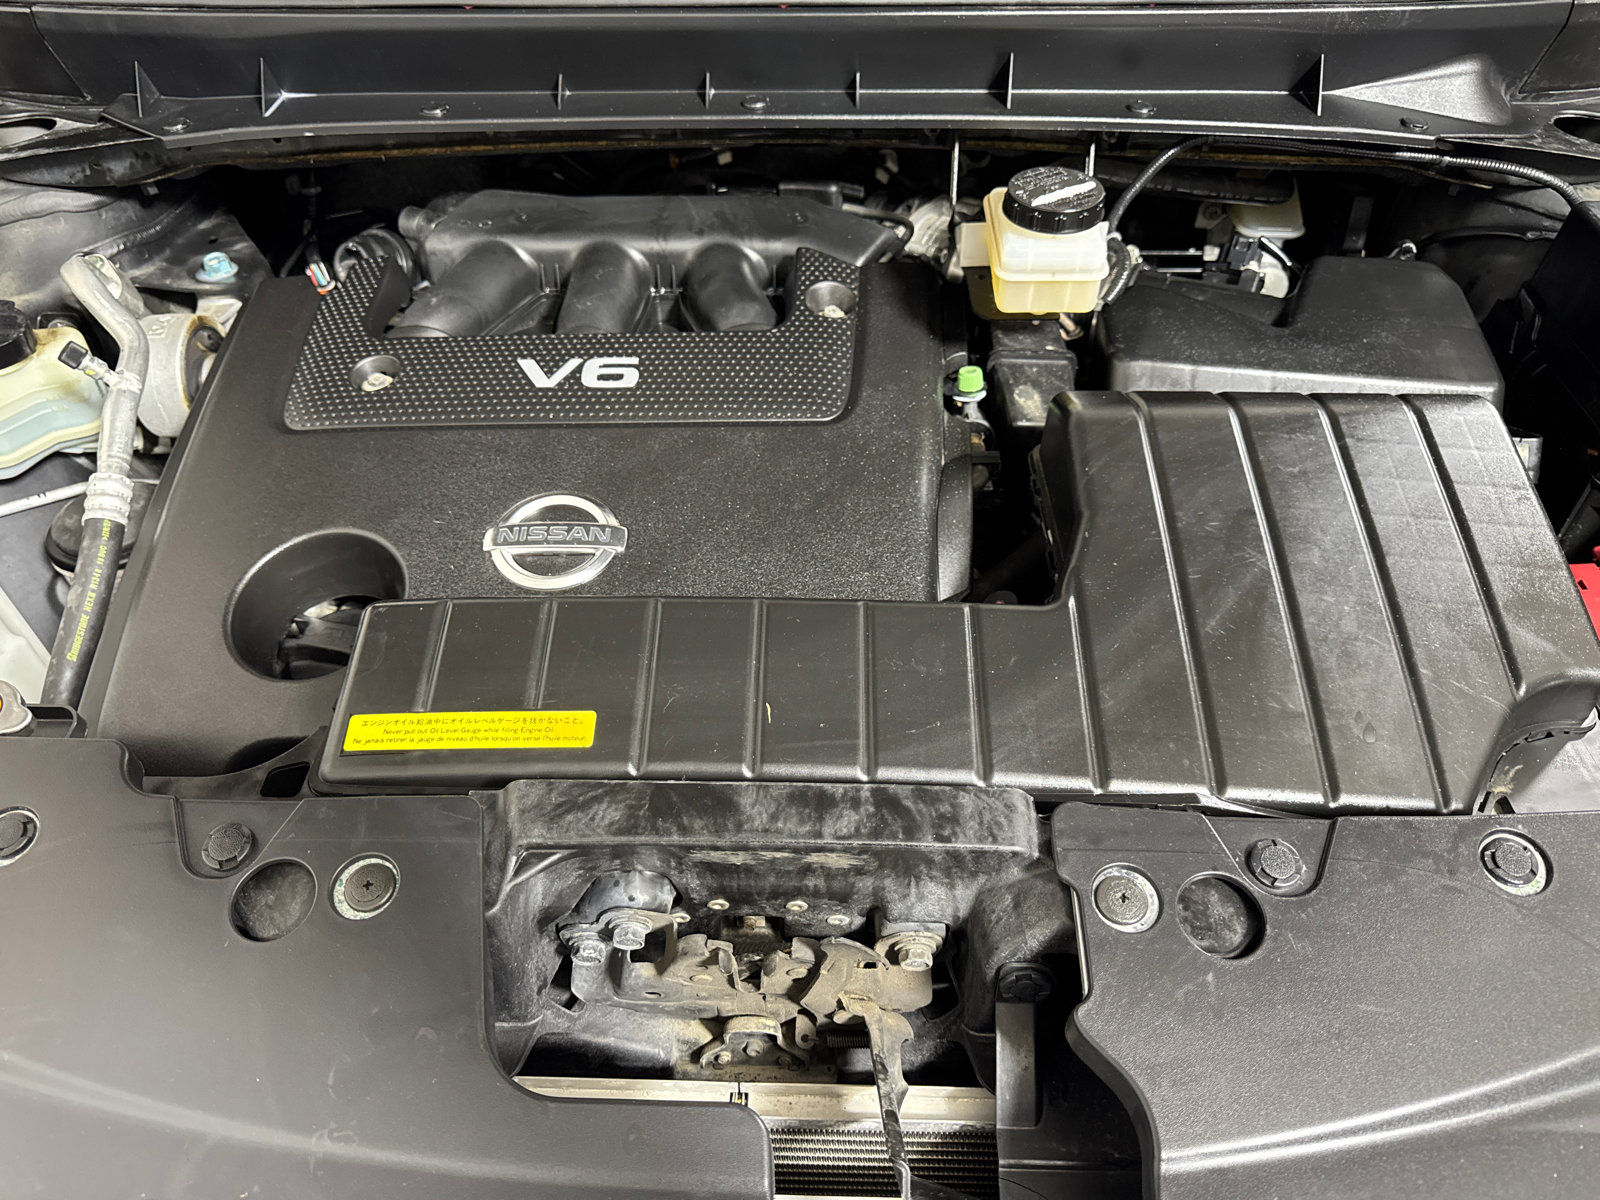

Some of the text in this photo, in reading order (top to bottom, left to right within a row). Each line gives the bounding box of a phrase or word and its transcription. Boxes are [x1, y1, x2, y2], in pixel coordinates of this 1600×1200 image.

[517, 357, 640, 388] V6
[497, 526, 612, 543] NISSAN
[67, 614, 89, 662] BRIDGESTONE
[520, 726, 543, 734] Engine
